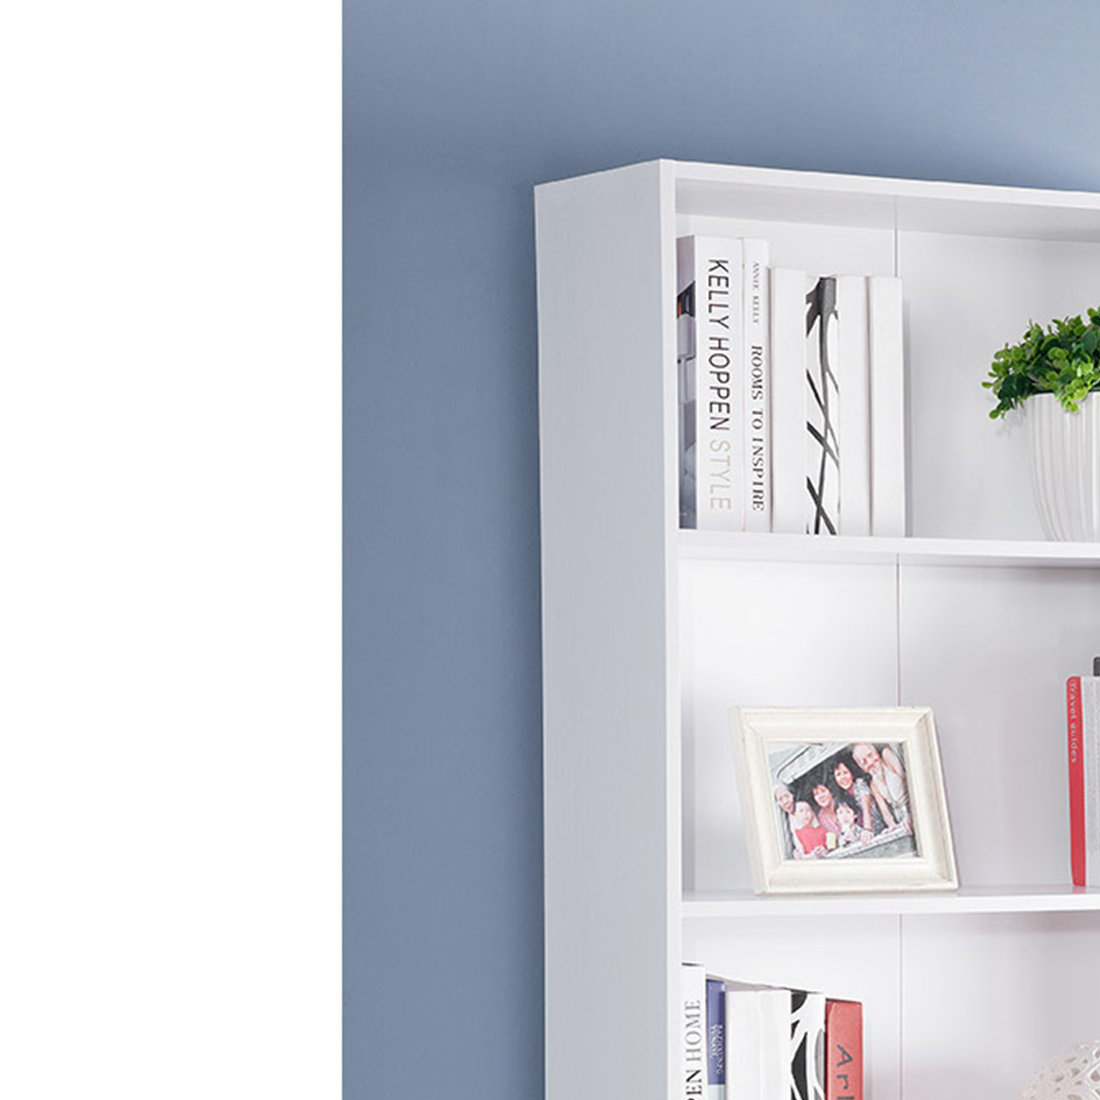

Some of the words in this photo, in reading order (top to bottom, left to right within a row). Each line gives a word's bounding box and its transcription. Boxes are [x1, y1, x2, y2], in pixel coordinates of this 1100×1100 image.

[708, 259, 730, 330] KELLY
[708, 337, 731, 431] HOPPEN
[751, 346, 763, 401] ROOMS
[752, 409, 764, 431] TO
[709, 439, 731, 510] STYLE
[752, 438, 765, 512] INSPIRE
[685, 1000, 702, 1063] HOME
